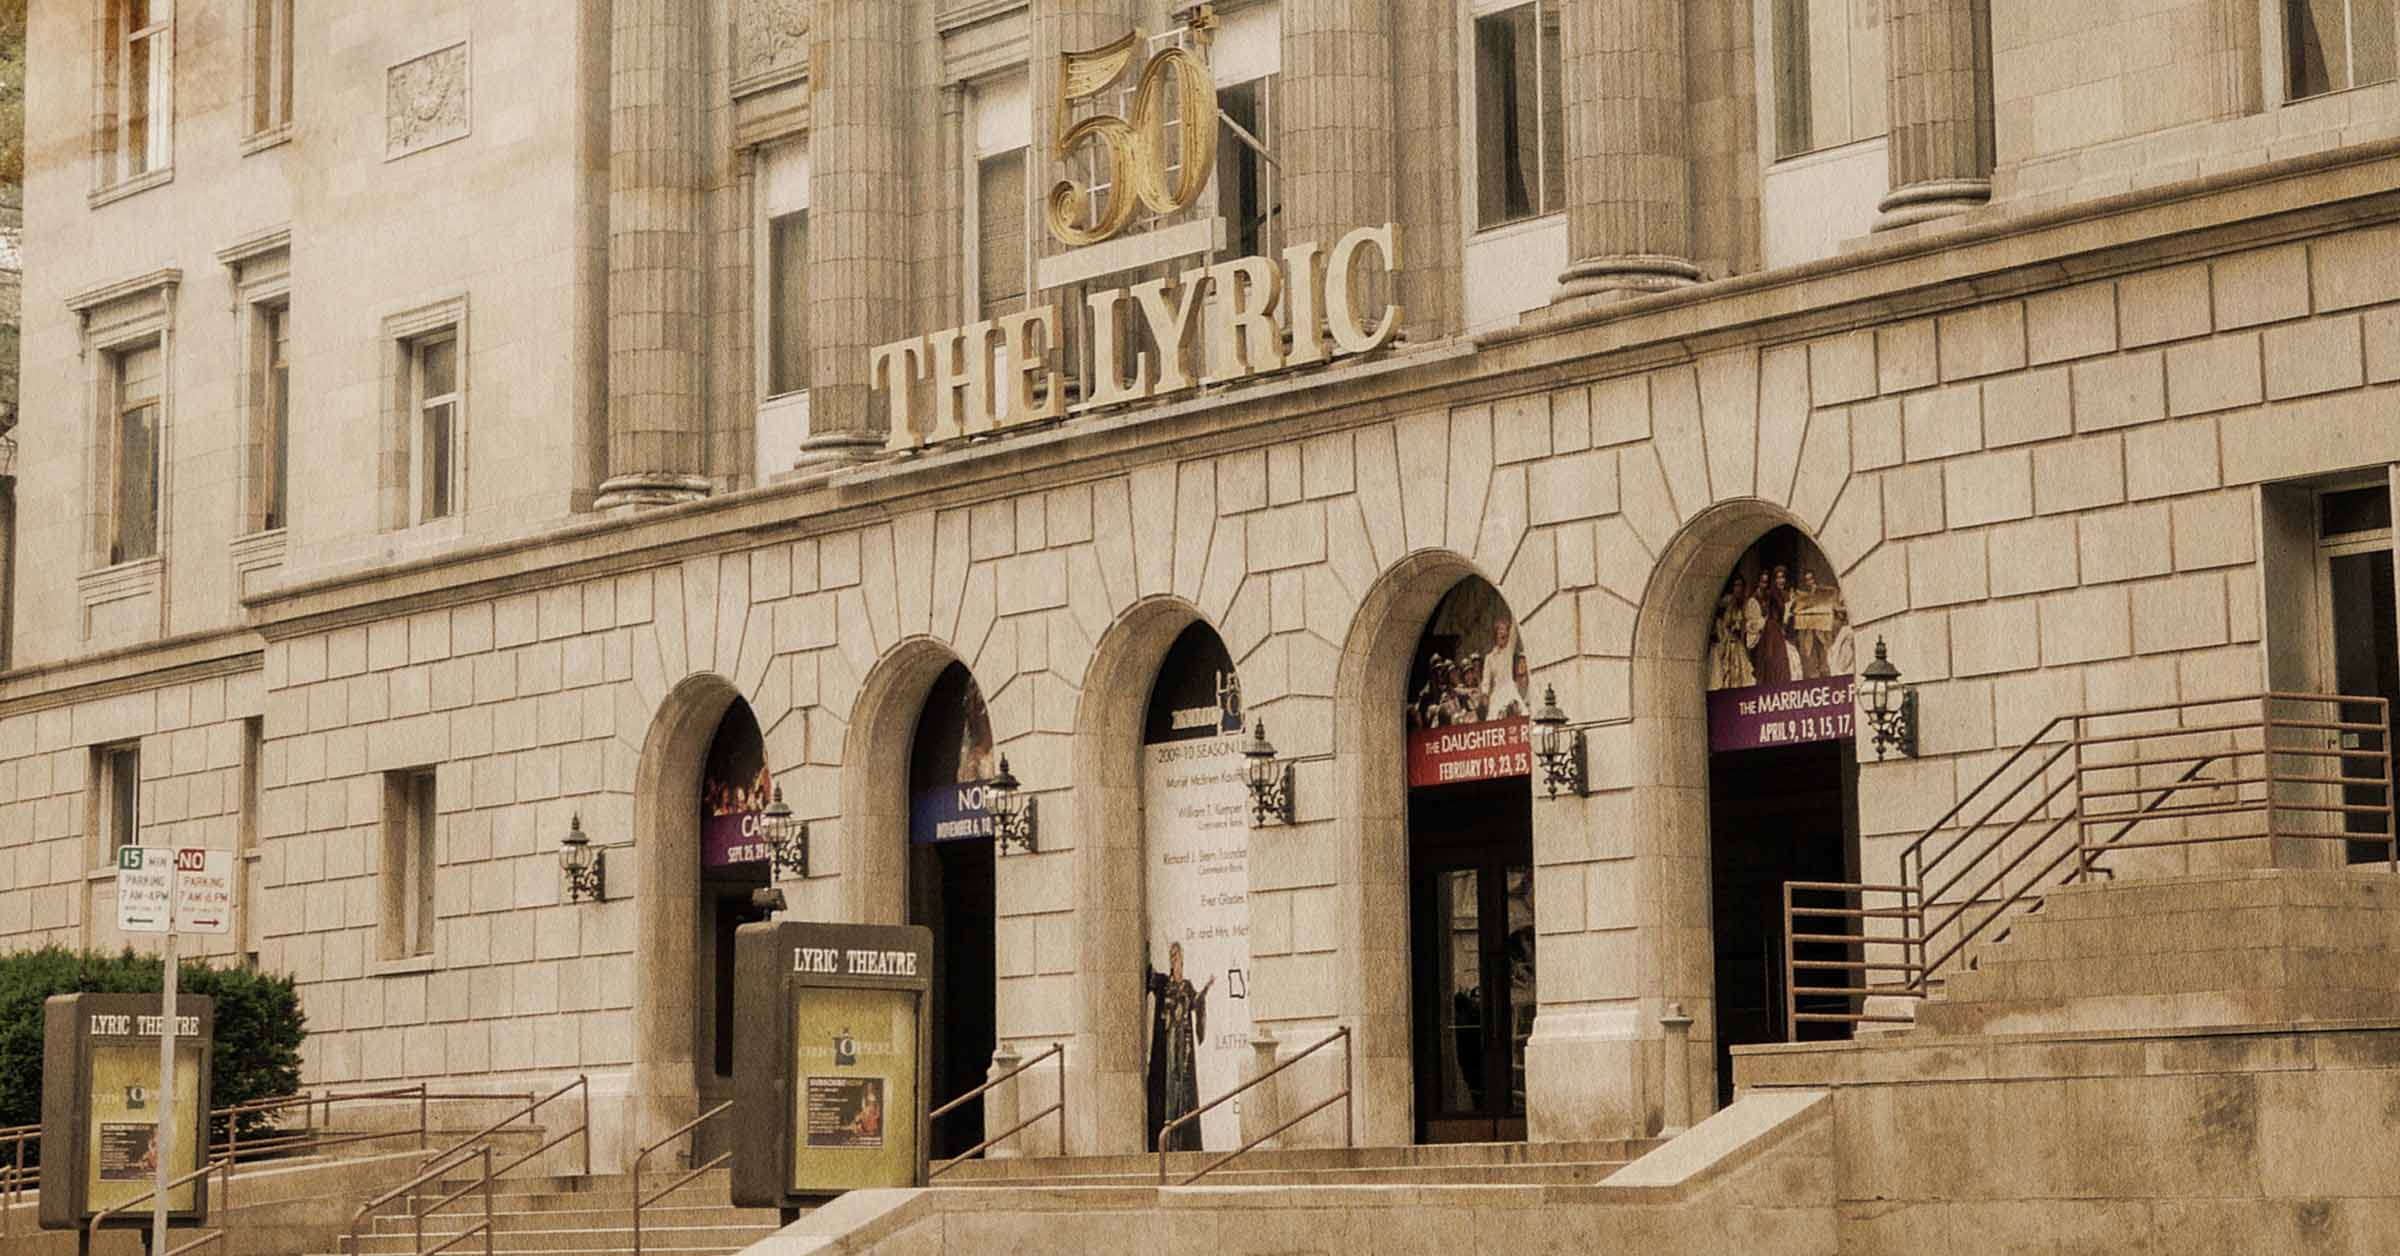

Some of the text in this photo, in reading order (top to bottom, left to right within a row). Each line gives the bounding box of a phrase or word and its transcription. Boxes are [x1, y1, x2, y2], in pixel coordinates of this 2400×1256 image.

[1048, 29, 1217, 246] 50
[870, 222, 1400, 452] THE LYRIC
[1738, 701, 1757, 715] THE
[1758, 686, 1830, 713] MARRIAGE
[1831, 690, 1846, 705] OF
[1425, 742, 1440, 754] THE
[1441, 727, 1506, 753] DAUGHTER
[1760, 713, 1854, 743] APRIL 9, 13, 15, 17,
[1196, 740, 1234, 759] SEASON
[1439, 752, 1530, 781] FEBRUARY 19, 23, 25,
[124, 852, 141, 868] 15
[179, 851, 204, 869] NO
[794, 948, 917, 976] LYRIC THEATRE
[91, 1015, 200, 1037] LYRIC THETRE
